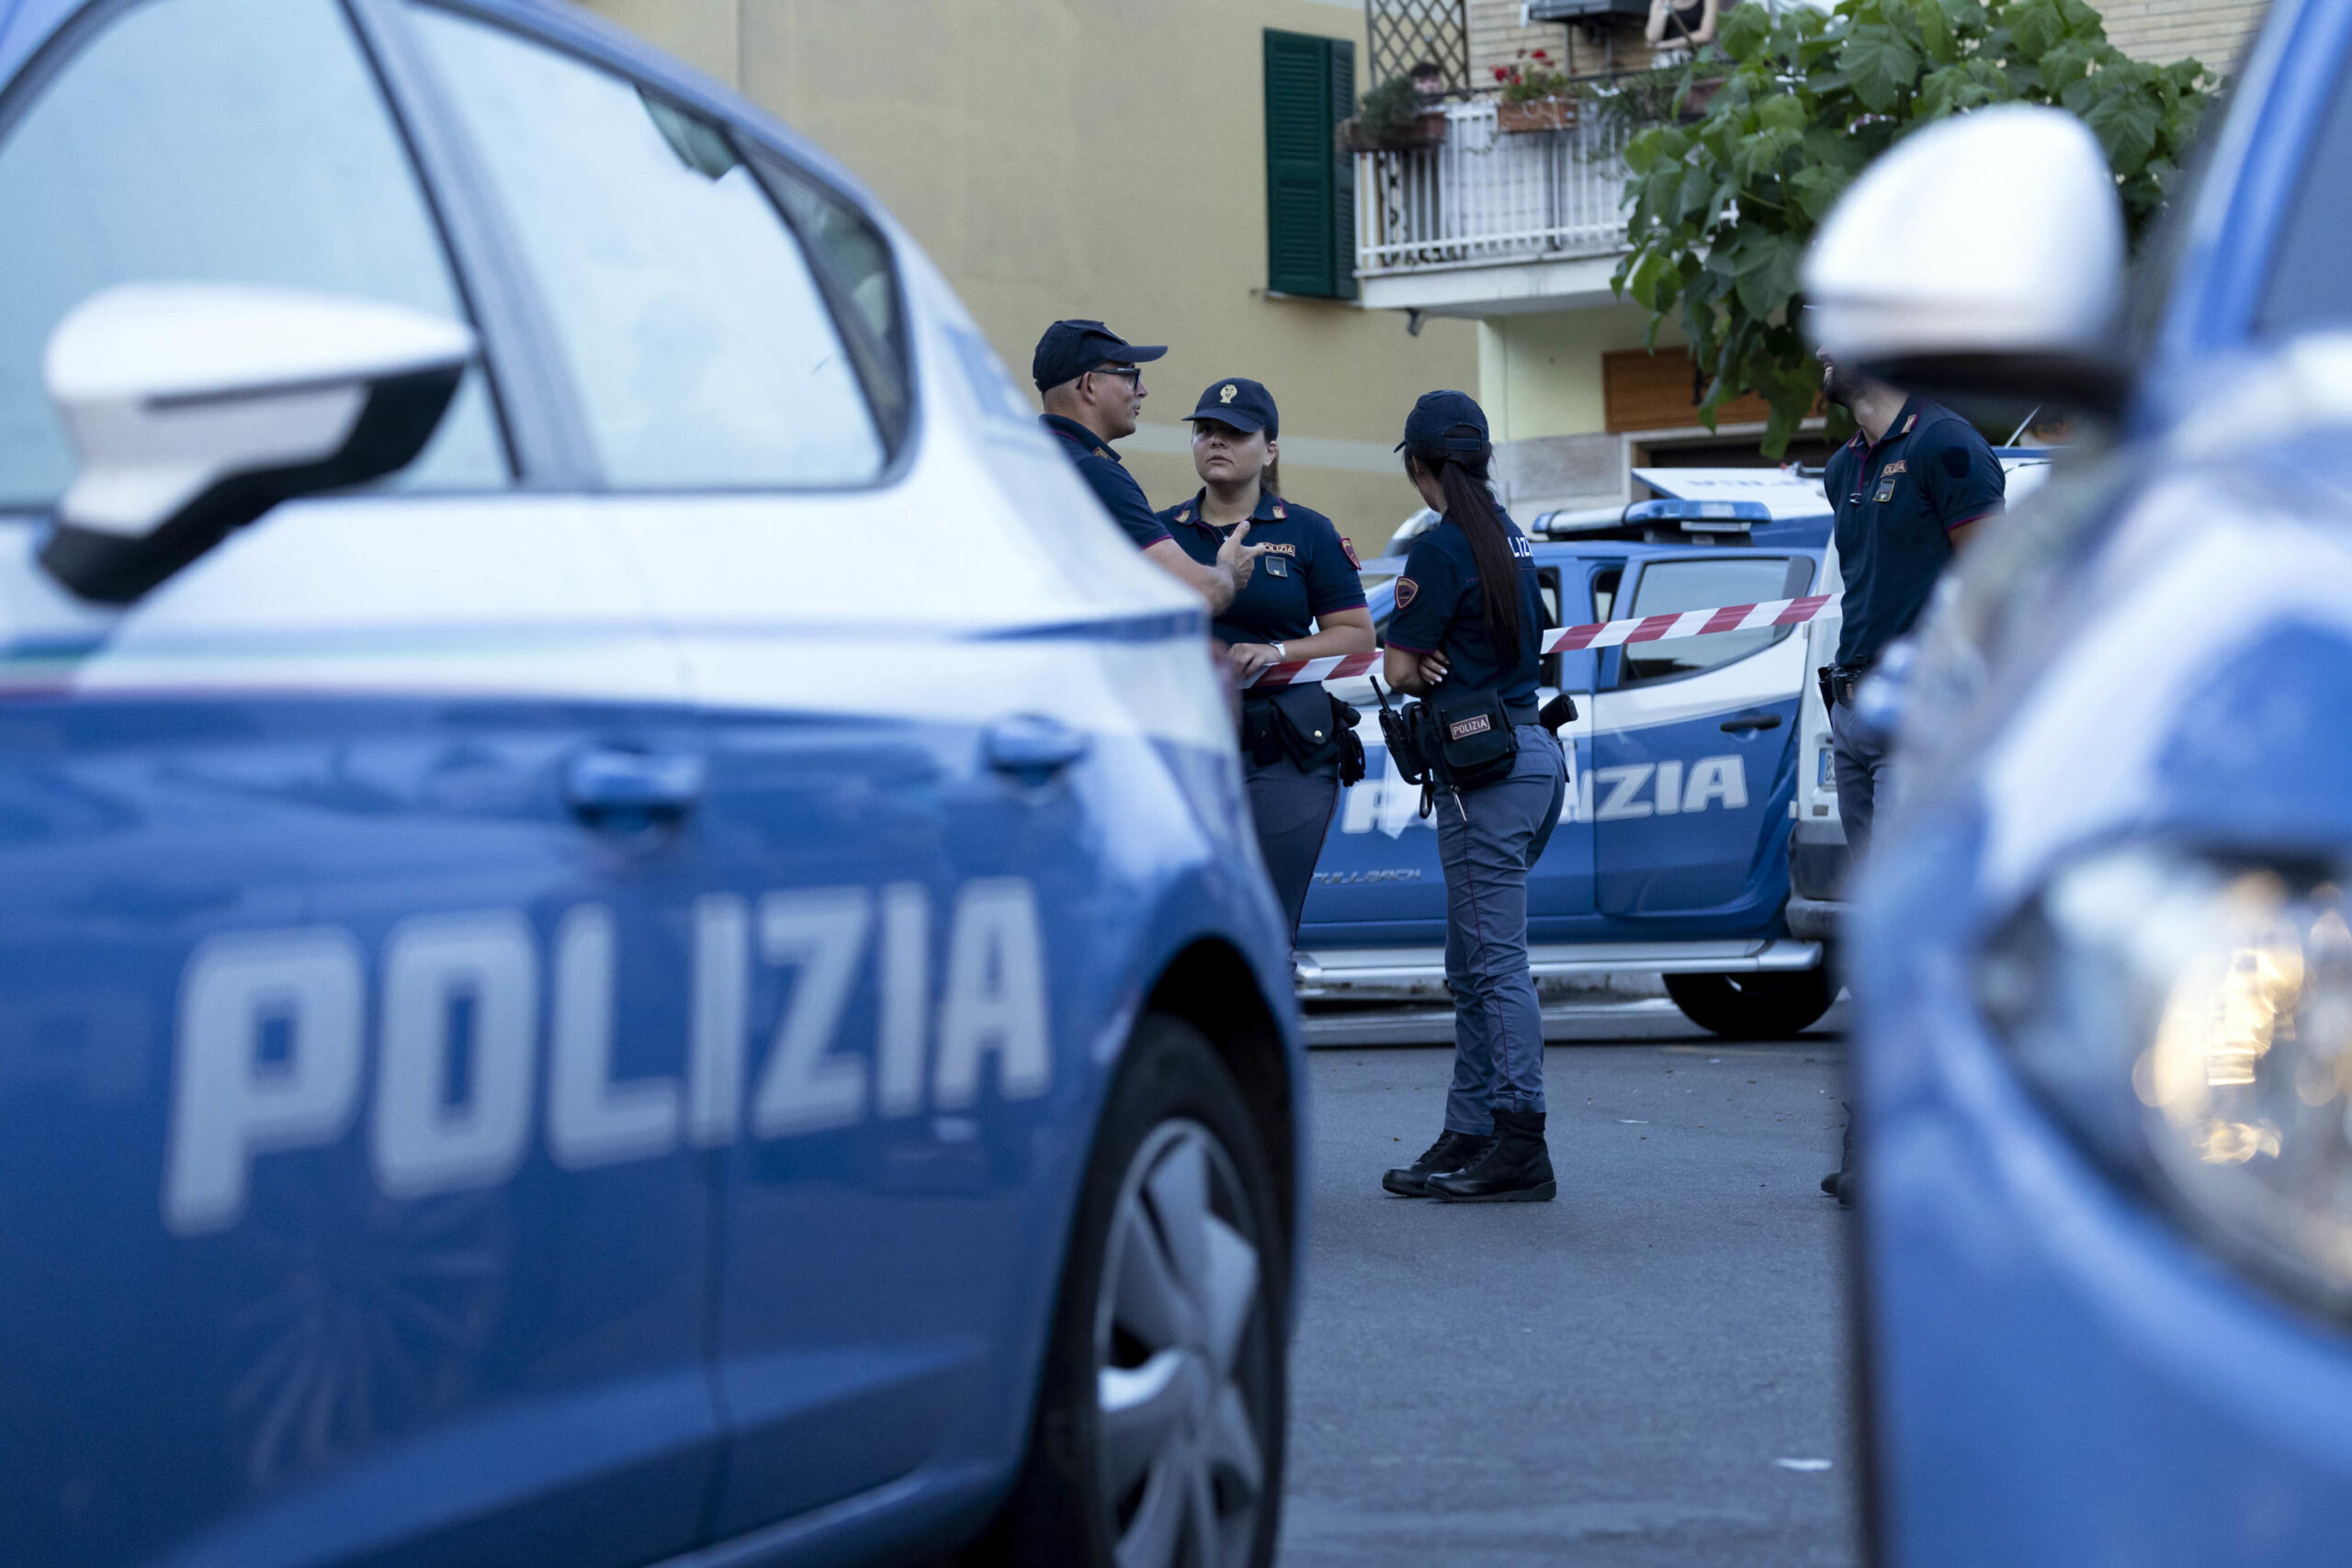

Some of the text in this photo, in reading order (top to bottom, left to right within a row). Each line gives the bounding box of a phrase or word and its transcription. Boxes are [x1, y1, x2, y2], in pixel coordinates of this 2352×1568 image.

[1263, 544, 1294, 553] OLIZIA
[1507, 536, 1533, 558] LIZI
[1453, 719, 1487, 736] POLIZIA
[1340, 753, 1748, 834] PIZIA
[163, 876, 1052, 1235] POLIZIA
